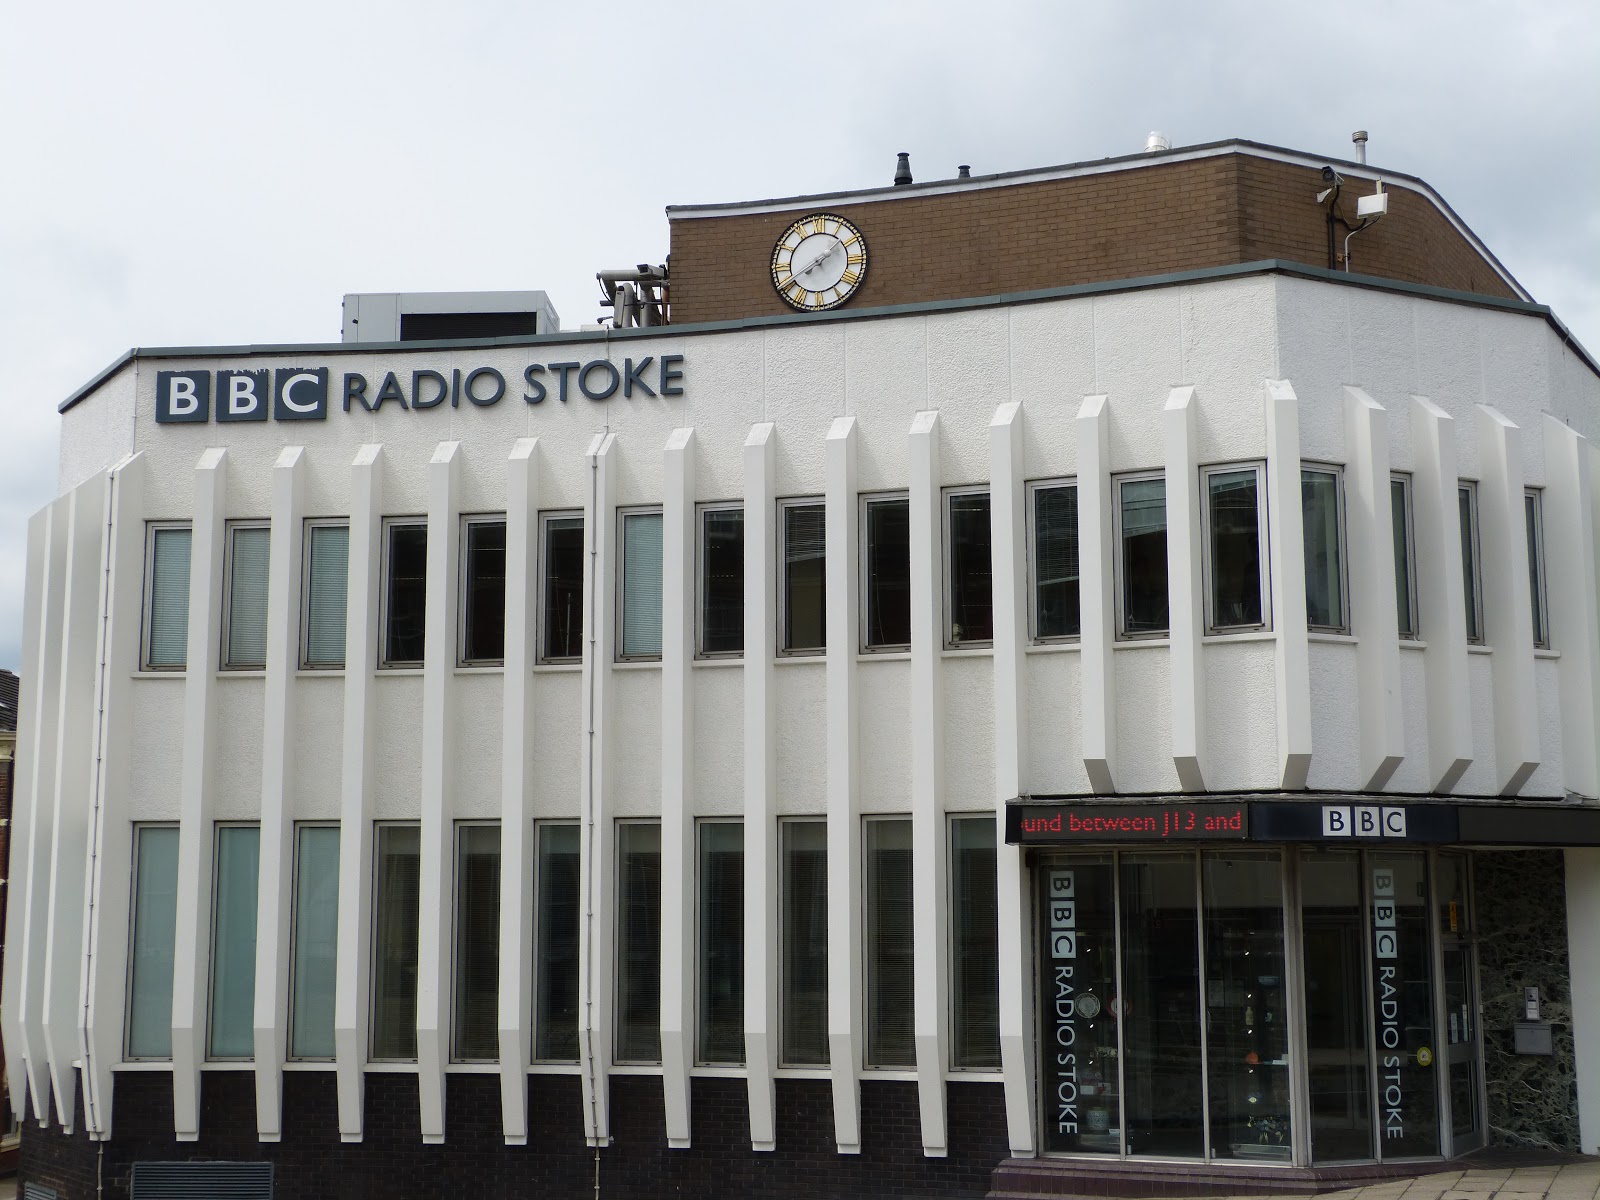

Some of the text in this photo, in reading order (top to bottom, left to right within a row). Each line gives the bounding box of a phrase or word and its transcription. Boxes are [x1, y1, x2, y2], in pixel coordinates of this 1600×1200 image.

[166, 354, 684, 417] BBC RADIO STOKE
[1021, 812, 1062, 832] und
[1069, 812, 1156, 833] between
[1205, 810, 1241, 830] and
[1326, 809, 1404, 835] BBC
[1051, 874, 1078, 1135] BBC RADIO STOKE
[1374, 872, 1404, 1140] BBC RADIO STOKE
